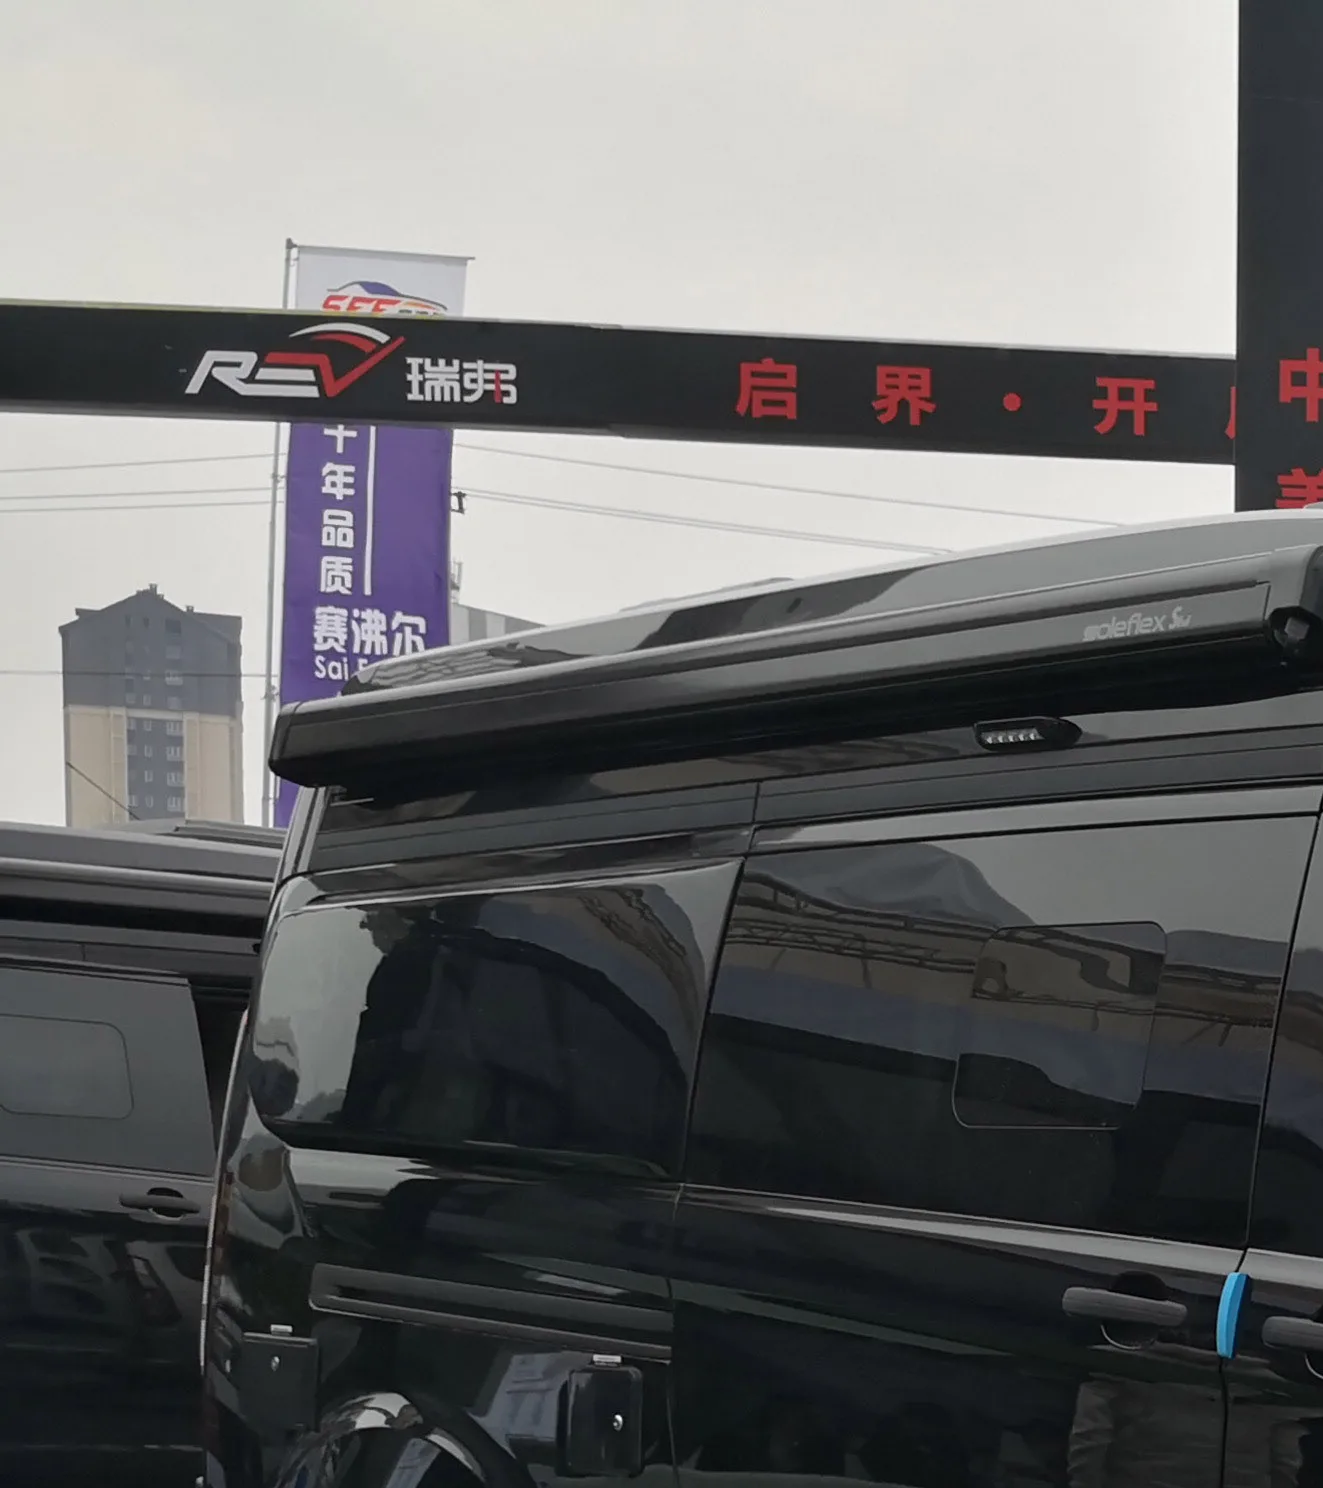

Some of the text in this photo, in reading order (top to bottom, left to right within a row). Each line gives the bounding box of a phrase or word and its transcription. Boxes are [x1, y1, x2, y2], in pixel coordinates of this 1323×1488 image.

[185, 328, 517, 404] REV 瑞弗
[320, 424, 358, 595] 十年品质
[315, 655, 349, 680] Sai
